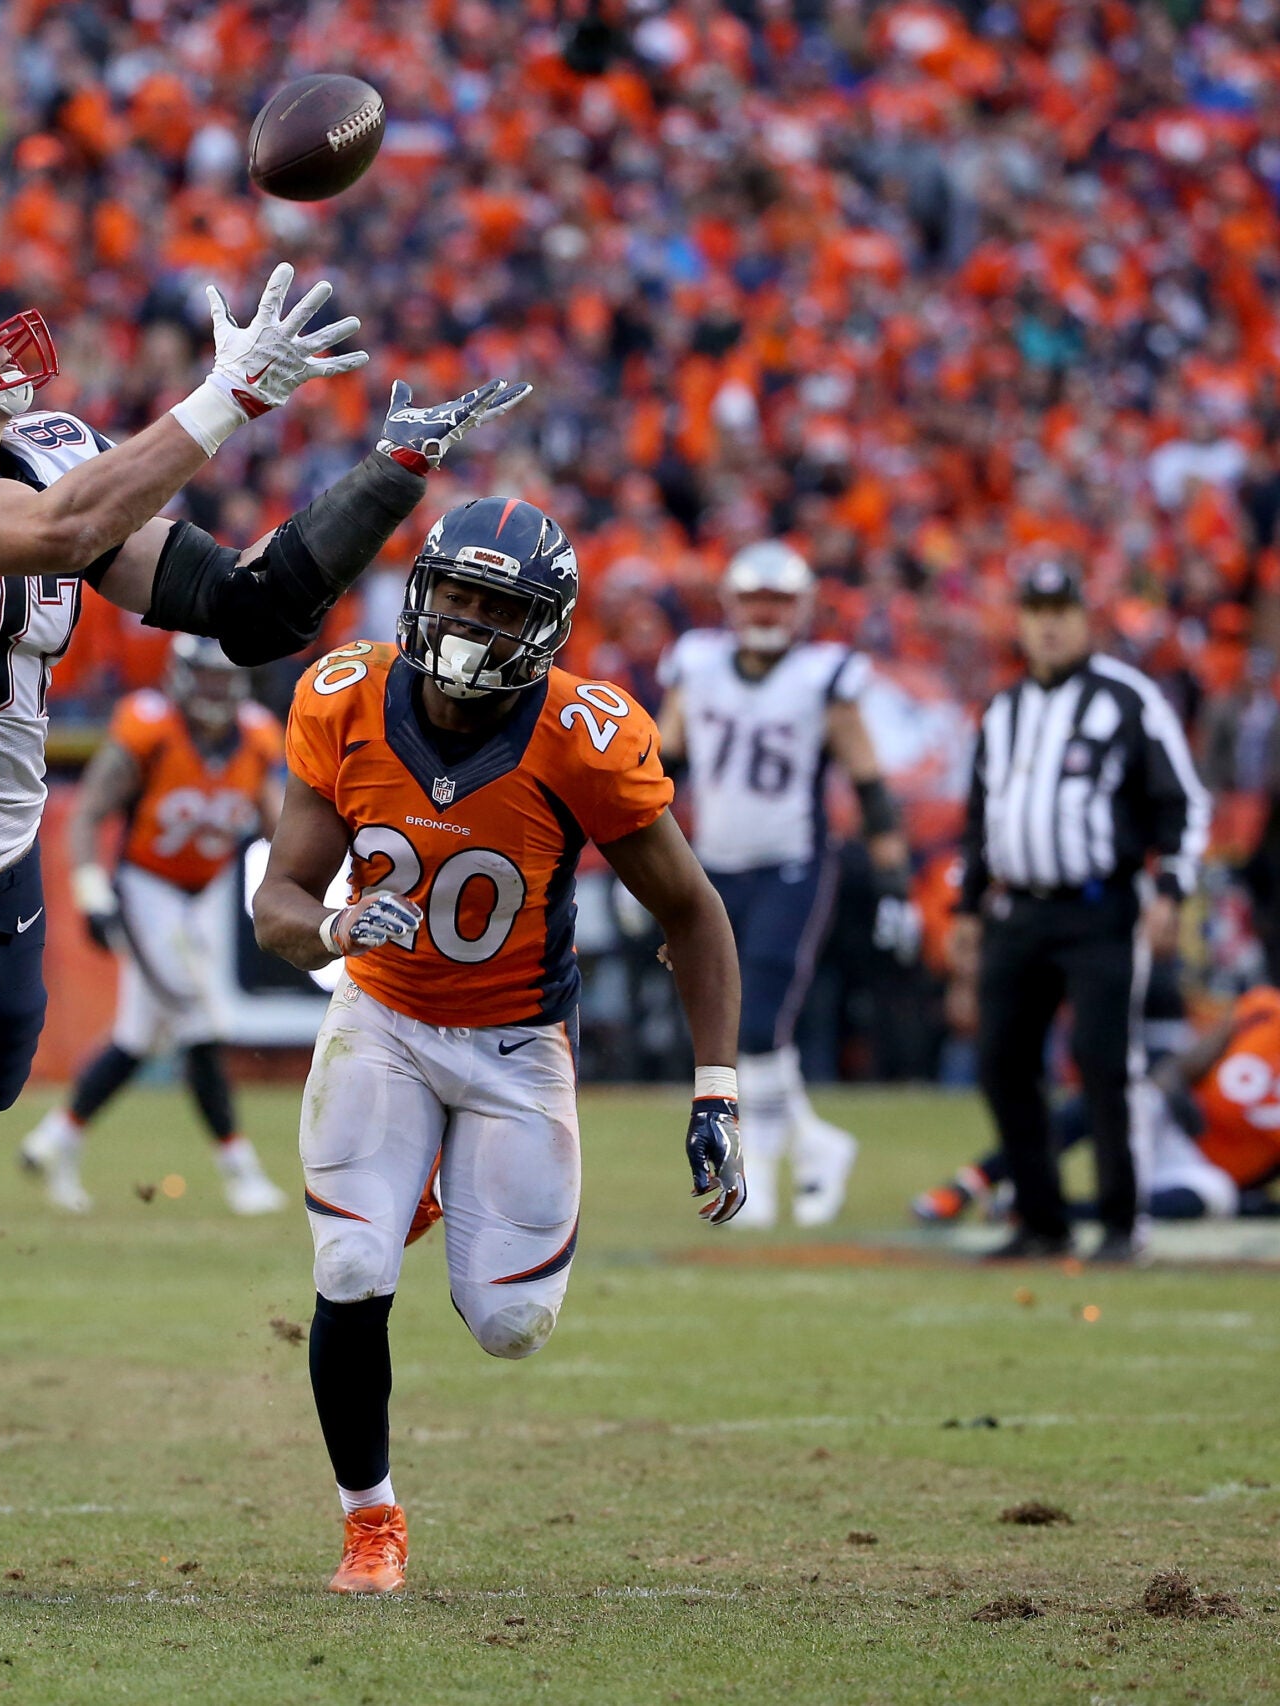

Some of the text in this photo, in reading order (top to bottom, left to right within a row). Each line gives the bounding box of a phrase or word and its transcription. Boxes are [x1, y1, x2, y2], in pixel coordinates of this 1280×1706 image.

[5, 413, 87, 450] 8
[473, 550, 505, 566] BRONCOS
[312, 641, 373, 696] 20
[559, 684, 630, 754] 20
[702, 709, 792, 797] 76
[405, 815, 471, 836] BRONCOS
[352, 823, 528, 966] 20
